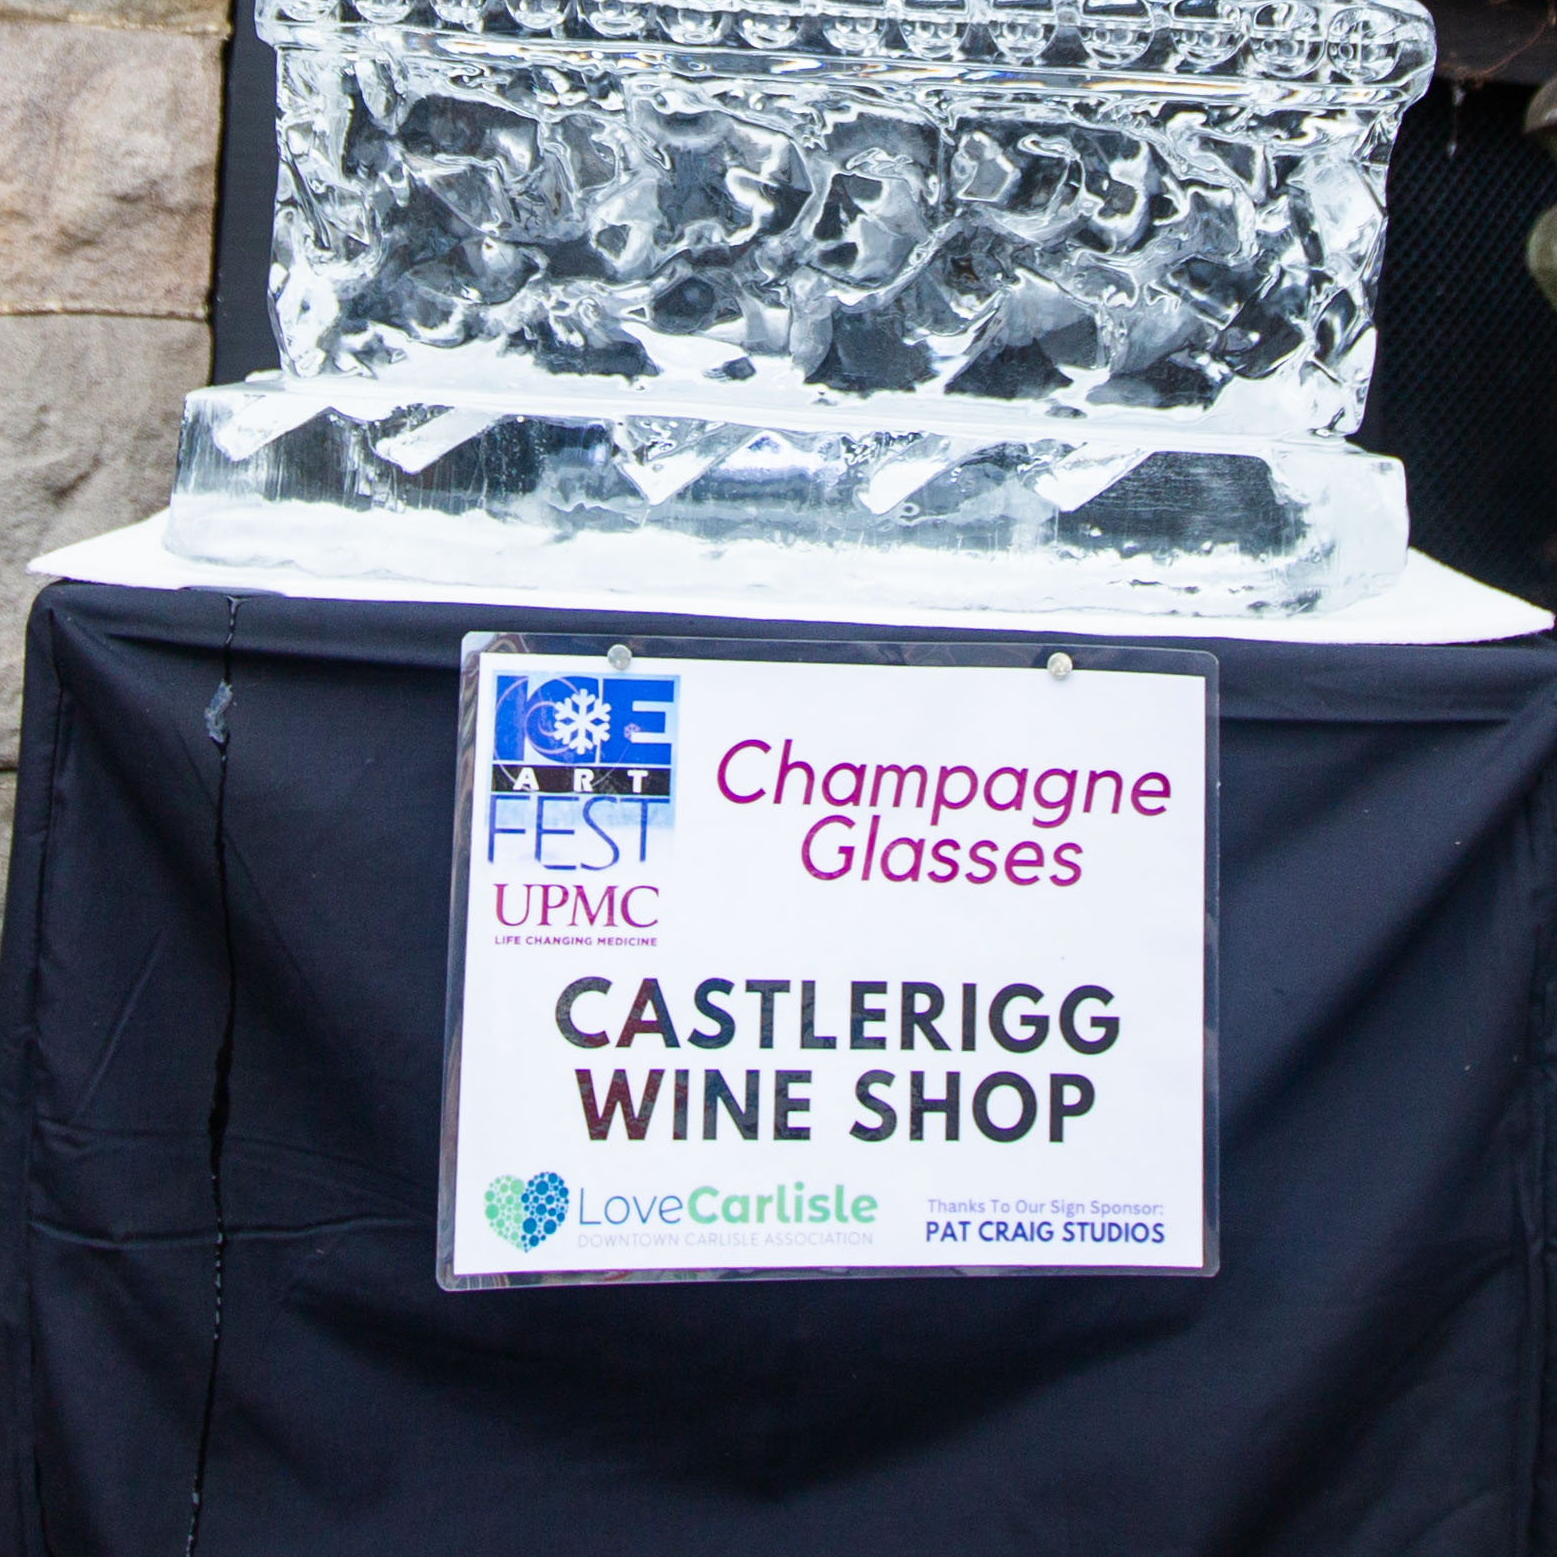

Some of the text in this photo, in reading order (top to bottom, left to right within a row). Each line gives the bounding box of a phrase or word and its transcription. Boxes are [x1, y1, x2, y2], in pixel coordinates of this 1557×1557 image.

[493, 675, 675, 764] ICE
[512, 766, 648, 793] ART
[717, 739, 1172, 829] Champagne
[488, 795, 670, 871] FEST
[801, 814, 1084, 887] Glasses
[493, 883, 659, 928] UPMC
[495, 935, 658, 947] LIFE CHANGING MEDICINE
[555, 976, 1120, 1055] CASTLERIGG
[574, 1069, 1095, 1143] WINE SHOP
[926, 1221, 1165, 1243] PAT CRAIG STUDIOS
[928, 1199, 1164, 1218] Thanks To Our Sign Sponsor:
[578, 1231, 874, 1248] DOWNTOWN CARLISLE ASSOCIATION
